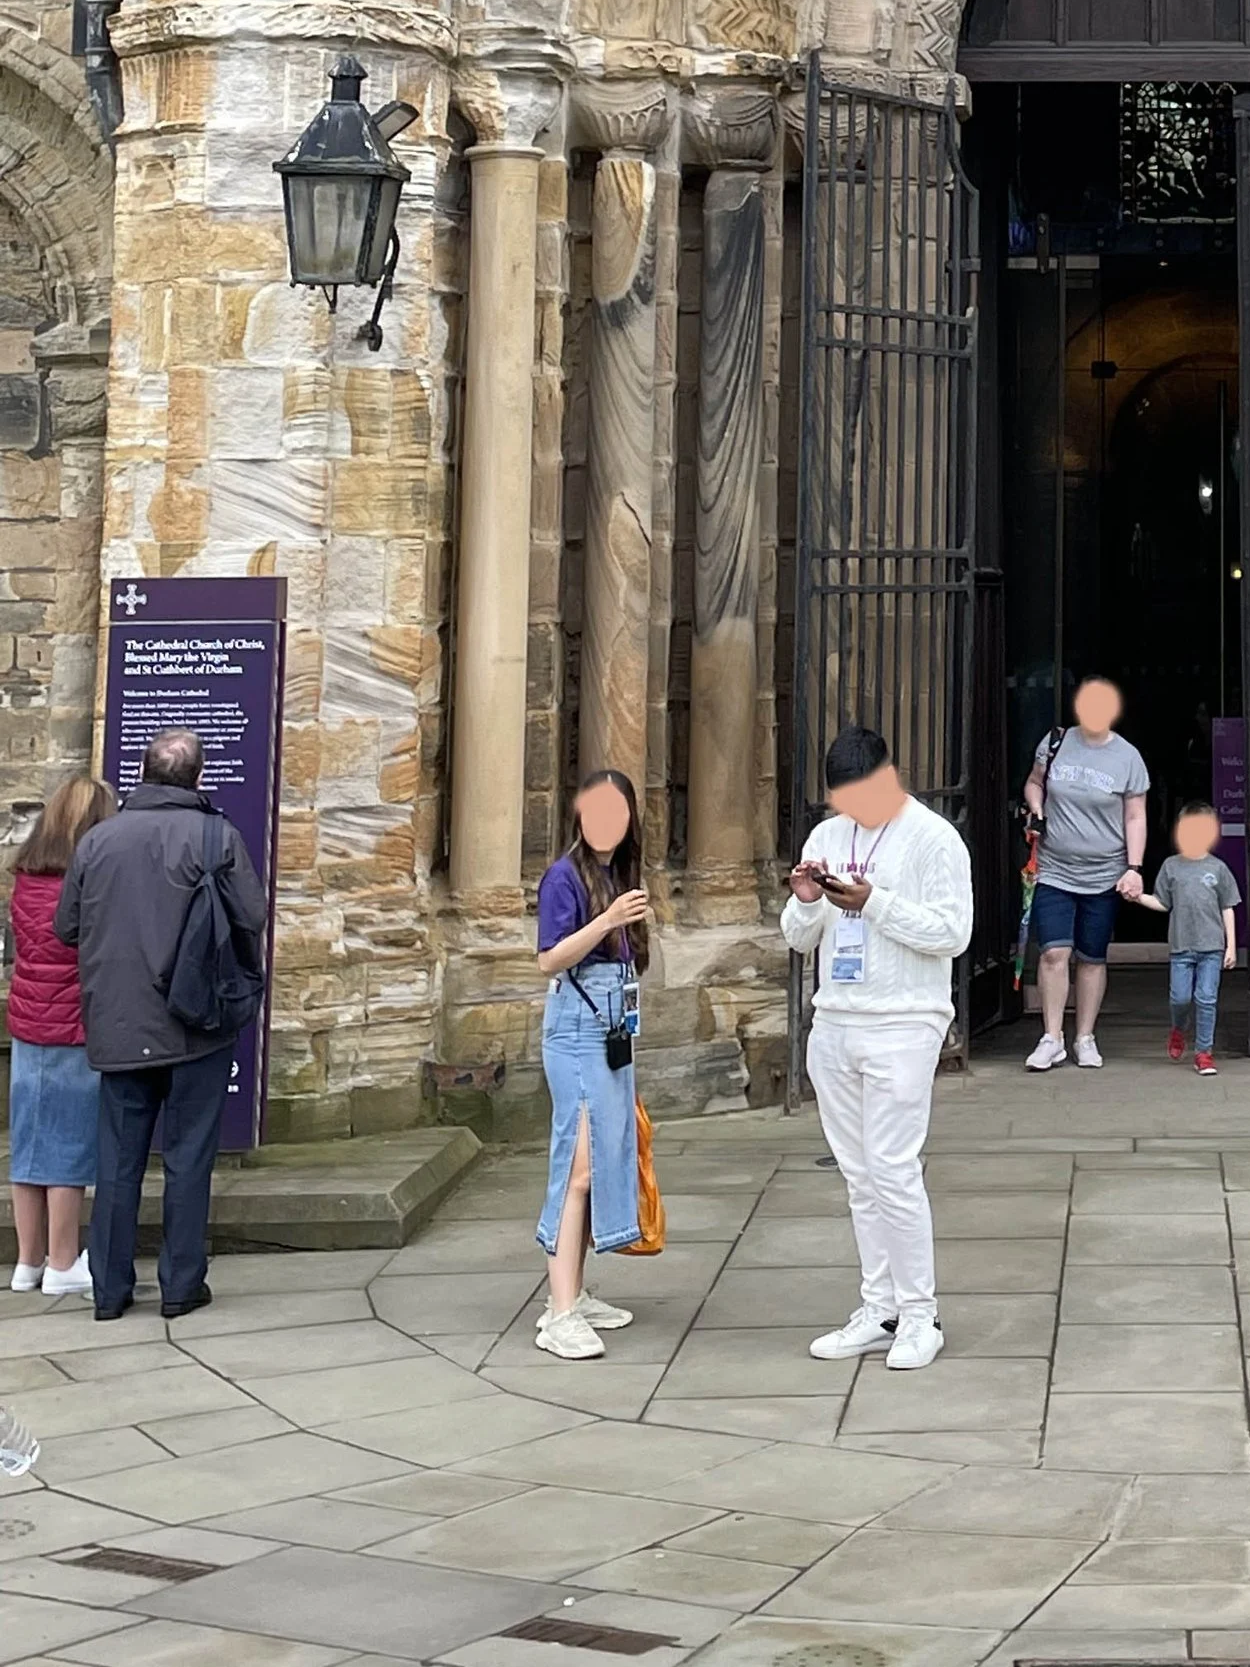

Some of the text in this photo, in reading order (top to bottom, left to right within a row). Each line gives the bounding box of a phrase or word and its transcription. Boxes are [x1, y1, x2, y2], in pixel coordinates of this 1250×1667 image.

[125, 640, 265, 650] The Cathedral Church of Christ,
[125, 652, 229, 664] Blessed Mary the Virgin
[124, 664, 242, 675] and St Cuthbert of Durham
[1221, 757, 1244, 766] Welco
[1223, 789, 1245, 799] Durh
[1220, 805, 1244, 815] Cathe
